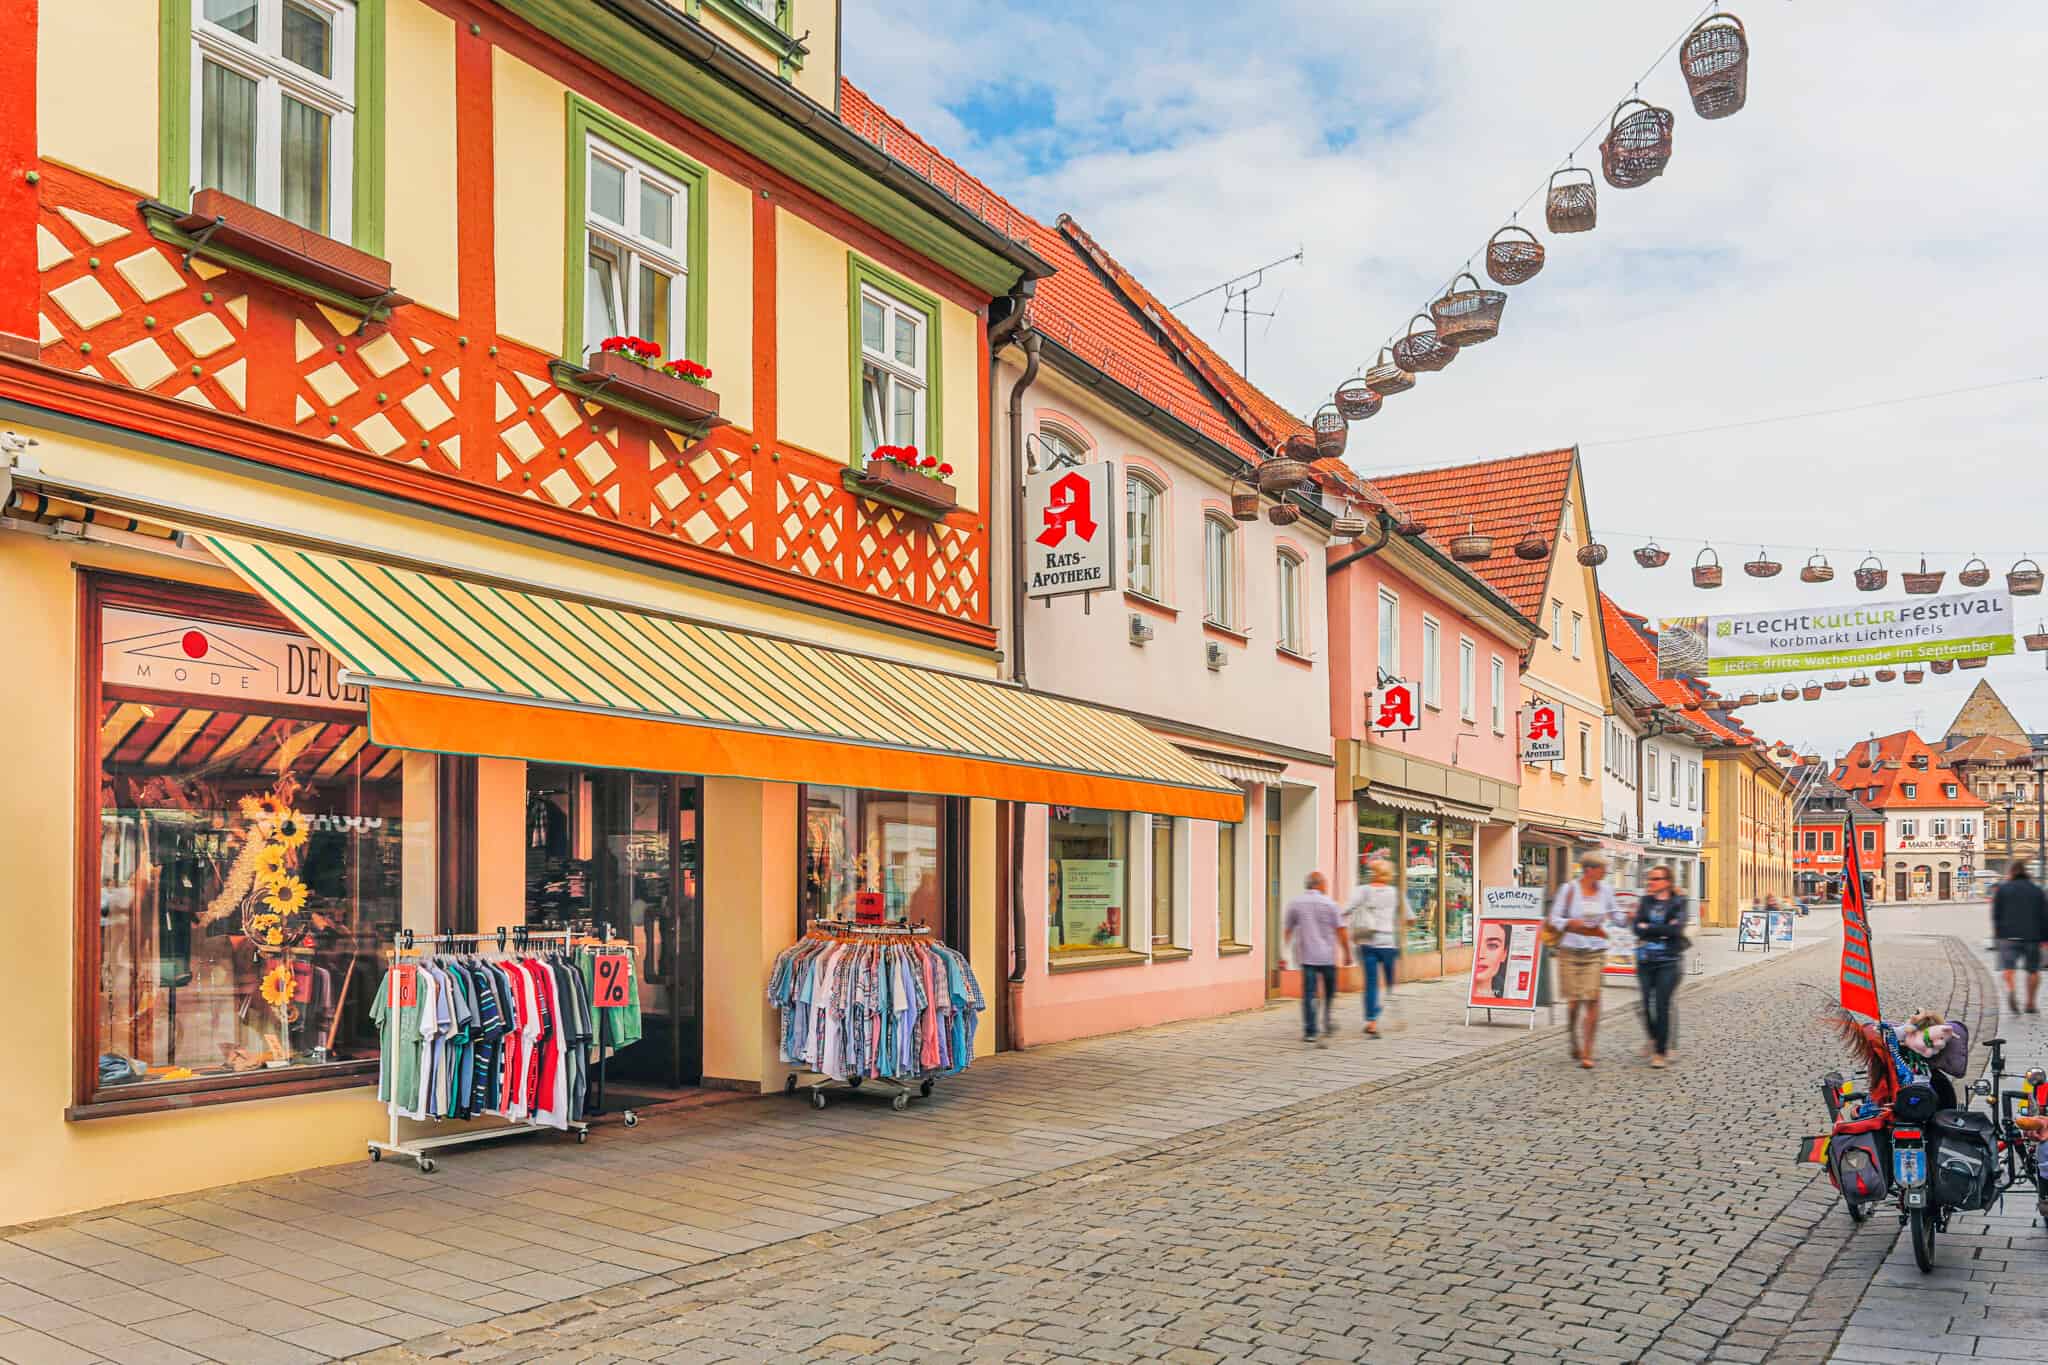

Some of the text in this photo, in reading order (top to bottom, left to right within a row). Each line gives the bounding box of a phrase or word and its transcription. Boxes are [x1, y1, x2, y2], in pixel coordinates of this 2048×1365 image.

[1032, 567, 1101, 588] APOTHEKE
[1770, 623, 1943, 648] Korbmarkt Lichtenfels
[1764, 656, 1800, 669] dritte
[1806, 650, 1890, 666] Wochenende
[1897, 648, 1912, 658] im
[1919, 640, 1995, 657] September
